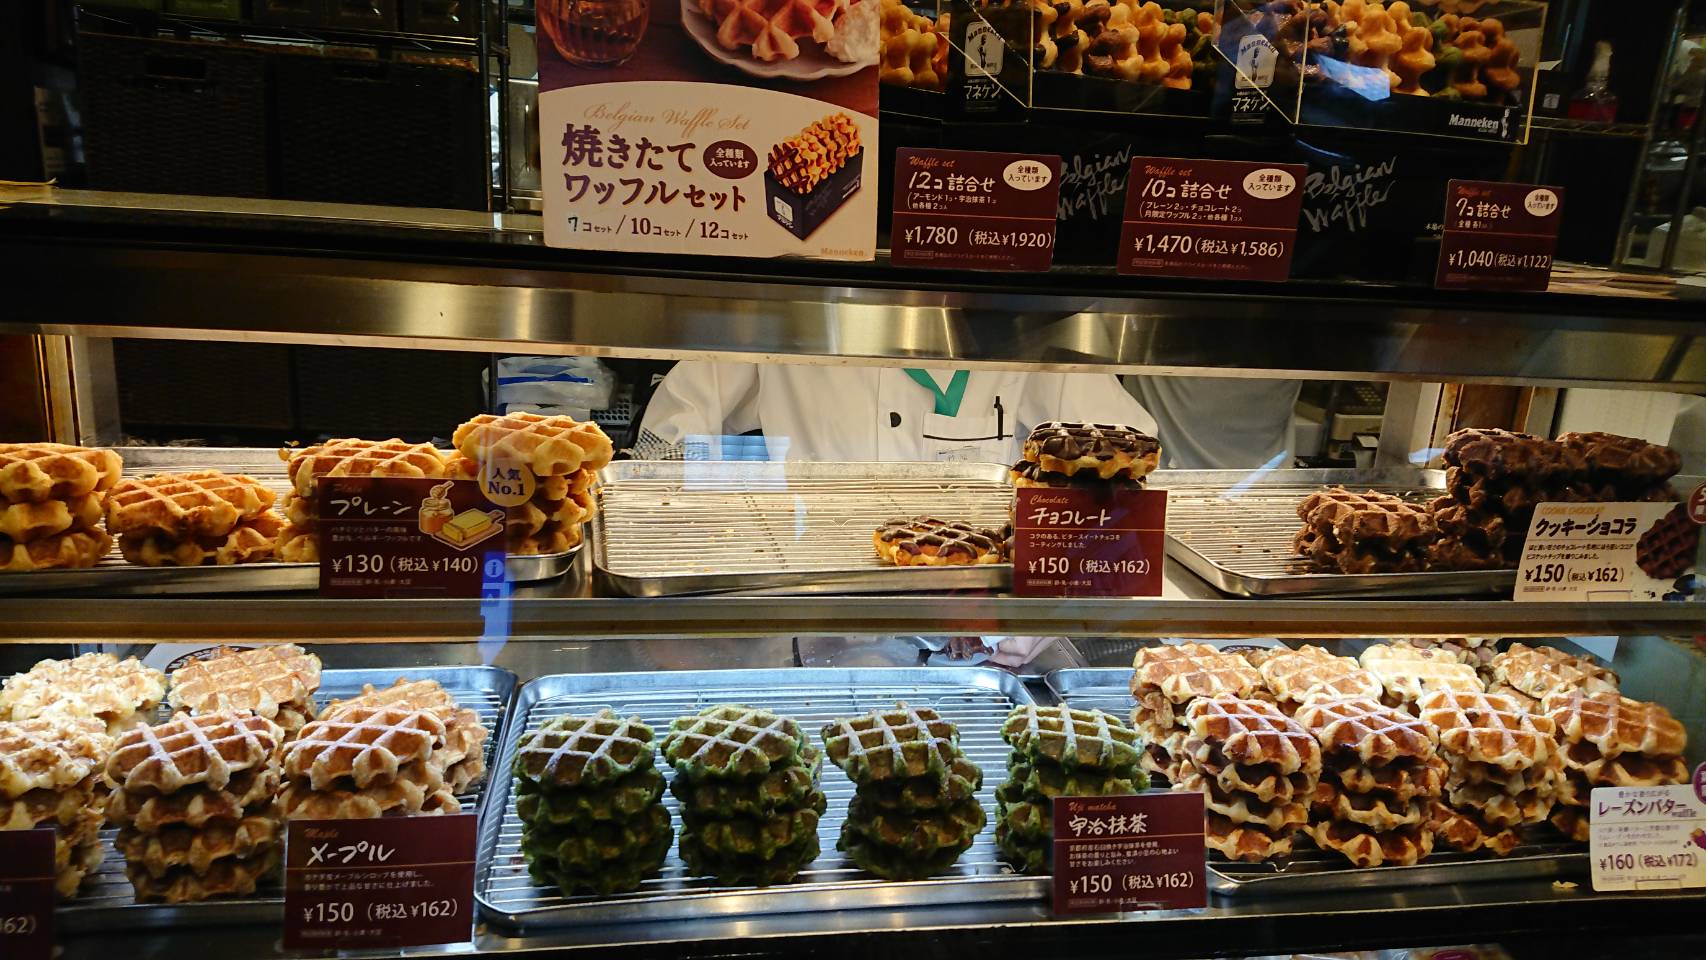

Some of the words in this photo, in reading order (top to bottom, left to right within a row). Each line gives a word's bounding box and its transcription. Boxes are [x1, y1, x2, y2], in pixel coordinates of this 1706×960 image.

[963, 85, 1002, 100] マネケン
[1232, 96, 1270, 113] マネケン
[583, 101, 656, 133] Belgian
[1448, 113, 1499, 129] Manneken
[561, 123, 697, 173] 焼きたて
[715, 147, 745, 159] 全種類
[709, 157, 751, 169] 入っています
[908, 155, 940, 169] Waffle
[942, 157, 957, 168] set
[1017, 165, 1039, 174] 全種類
[1143, 164, 1176, 179] Waffle
[1178, 167, 1193, 176] set
[947, 173, 996, 193] 詰合せ
[1007, 174, 1048, 184] 入っています
[1248, 182, 1291, 193] 入っています
[563, 173, 747, 213] ワッフルセット
[1180, 180, 1232, 200] 詰合せ
[1476, 200, 1512, 219] 詰合せ
[904, 225, 958, 246] ¥1,780
[1134, 233, 1192, 255] ¥1,470
[1448, 249, 1494, 269] ¥1,040
[492, 467, 522, 481] 人気
[487, 480, 526, 497] No.1
[329, 496, 414, 516] プレーン
[1029, 494, 1070, 505] Chocolate
[1027, 507, 1112, 527] チョコレート
[1535, 513, 1638, 537] クッキーショコラ
[331, 554, 384, 574] ¥130
[390, 555, 478, 574] (税込¥140)
[1028, 556, 1070, 575] ¥150
[1079, 558, 1151, 576] (税込¥162)
[1525, 563, 1565, 583] ¥150
[1598, 798, 1687, 817] レーズンバター
[1068, 812, 1149, 837] 宇治抹茶
[306, 841, 396, 867] メープル
[1599, 853, 1634, 871] ¥160
[1070, 874, 1112, 894] ¥150
[1122, 871, 1194, 891] (税込¥162)
[303, 902, 355, 923] ¥150
[367, 898, 458, 921] (税込¥162)
[0, 915, 37, 935] 62)
